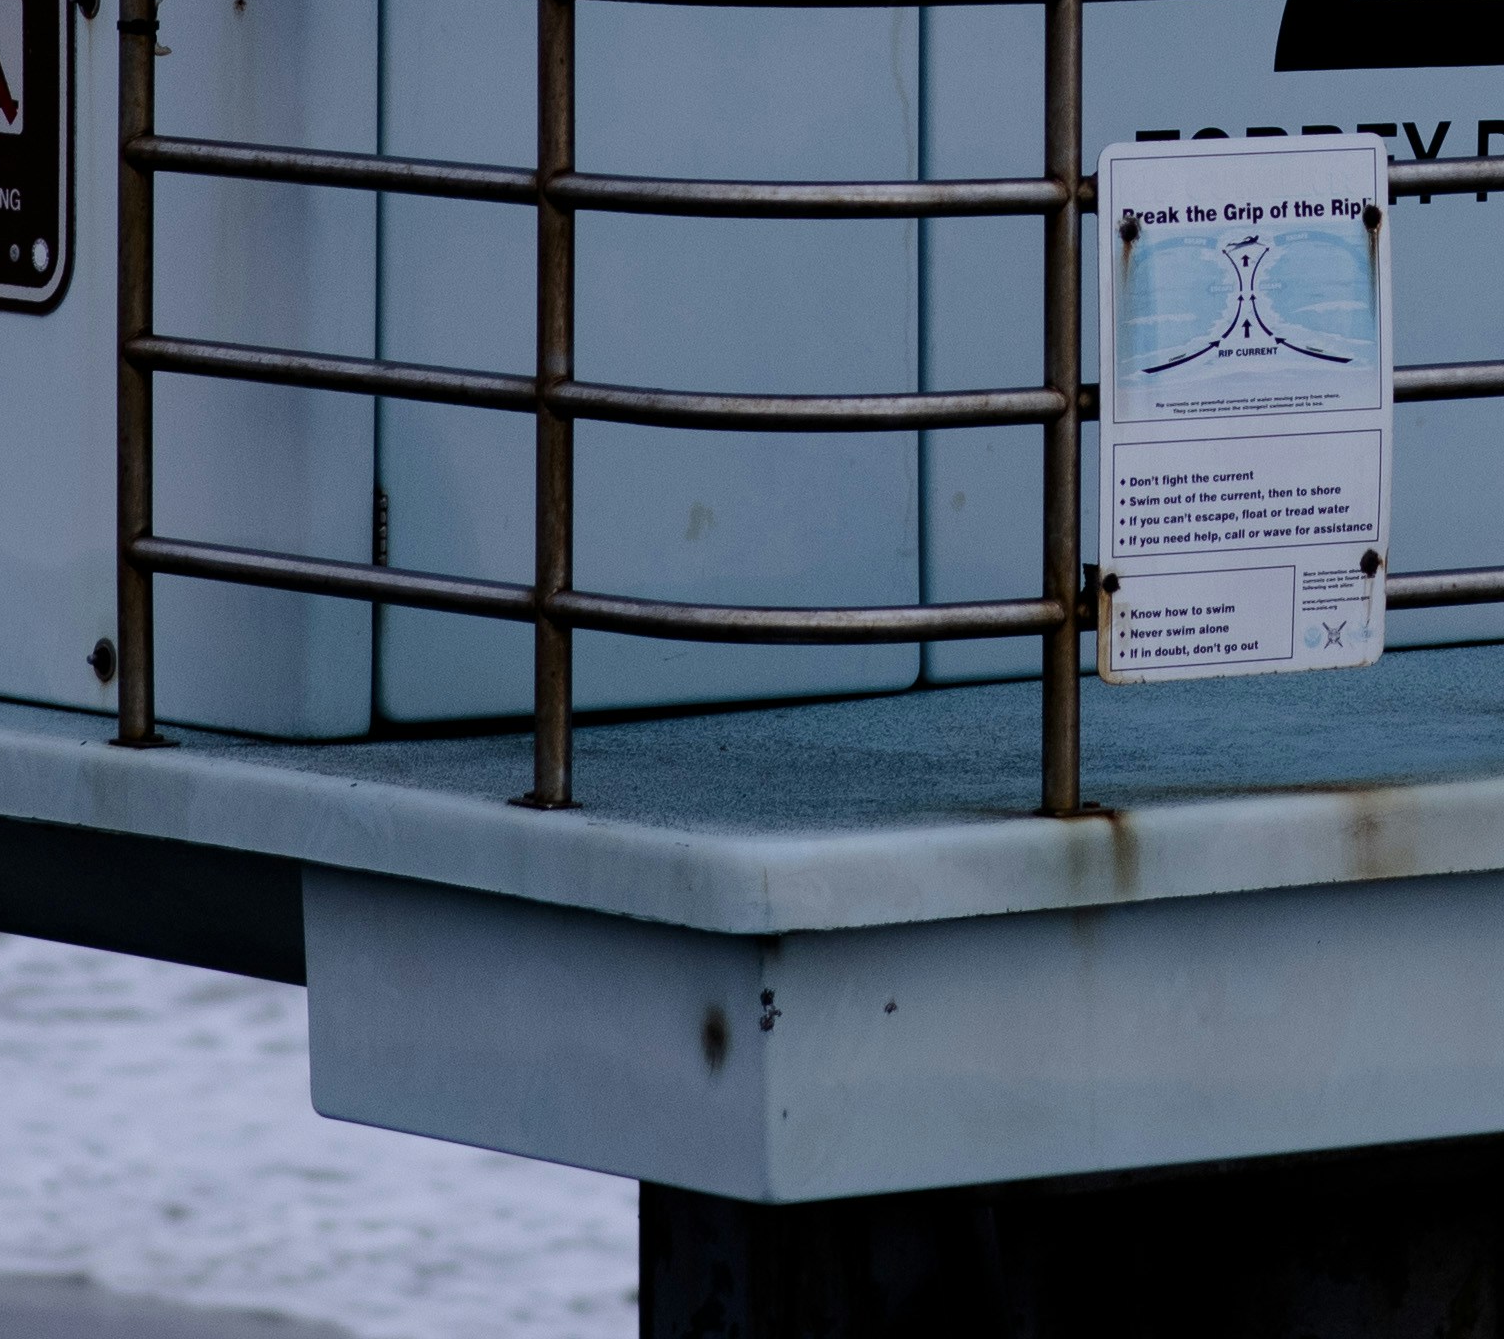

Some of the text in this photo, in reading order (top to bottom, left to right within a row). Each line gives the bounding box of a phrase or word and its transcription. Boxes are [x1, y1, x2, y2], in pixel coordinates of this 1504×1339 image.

[1186, 206, 1217, 222] the
[1224, 203, 1263, 224] Grip
[1270, 201, 1288, 218] of
[1294, 201, 1324, 217] the
[1216, 346, 1279, 359] RIP CURRENT
[1129, 470, 1254, 488] Don't fight the current
[1129, 485, 1342, 507] Swim out of the current, then to shore
[1129, 504, 1350, 529] If you can't escape, float or tread water
[1128, 522, 1373, 548] If you need help, call or wave for assistance
[1130, 603, 1236, 620] Know how to swim
[1130, 623, 1230, 640] Never swim alone
[1130, 640, 1259, 659] If in doubt, don't go out
